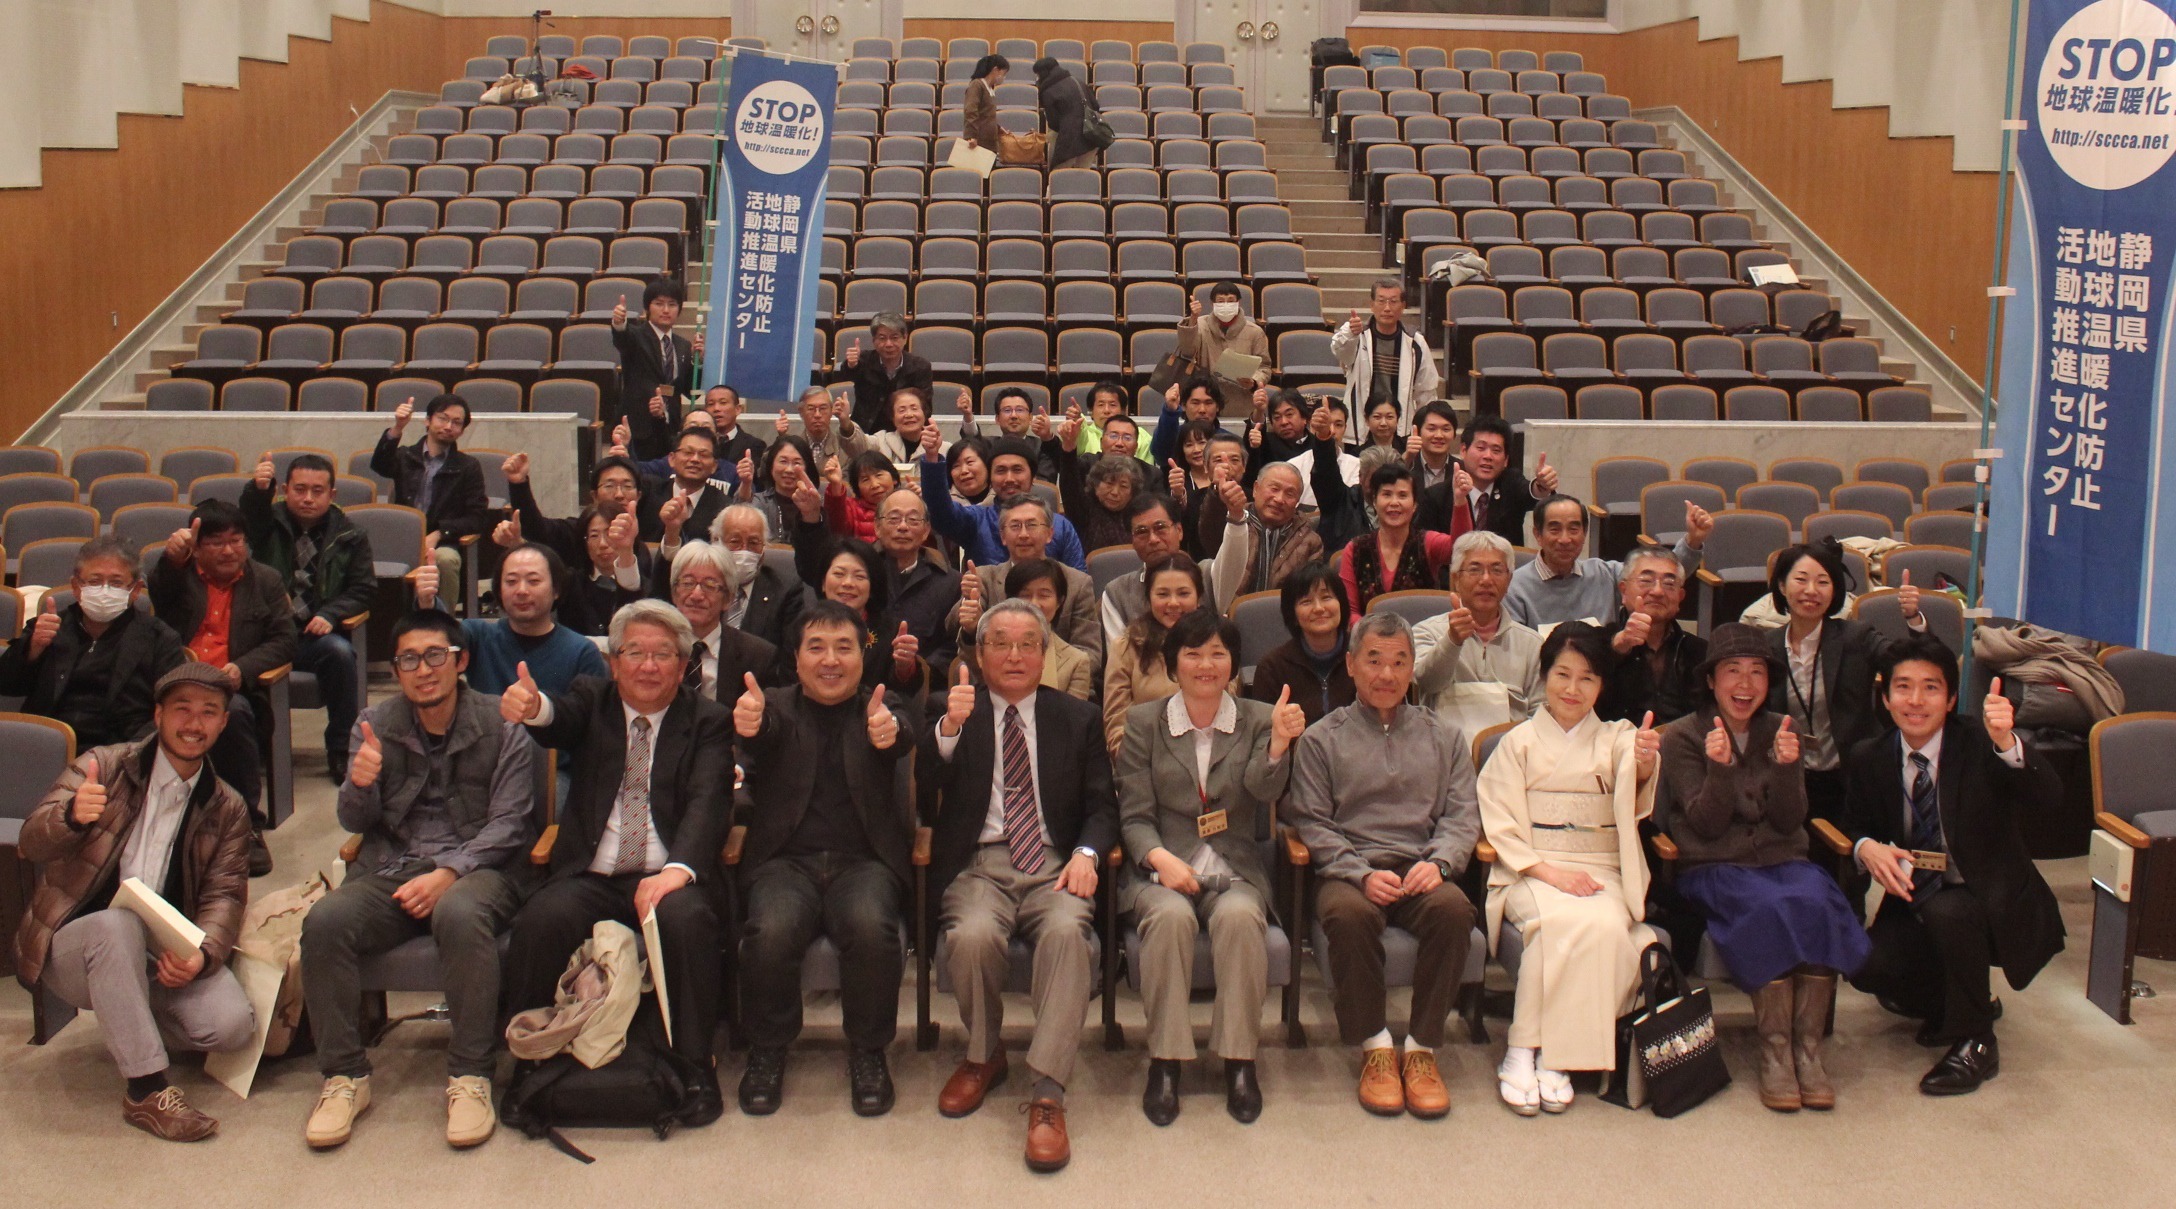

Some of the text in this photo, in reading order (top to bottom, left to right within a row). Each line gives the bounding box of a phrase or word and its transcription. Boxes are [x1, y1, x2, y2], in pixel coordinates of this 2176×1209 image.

[2058, 38, 2176, 81] STOP
[748, 97, 816, 124] STOP
[2044, 84, 2176, 116] 地球温暖化
[740, 119, 819, 141] 地球温暖化!
[744, 141, 810, 156] http://sccca.net
[2051, 128, 2169, 150] http://sccca.net
[779, 194, 801, 254] 静岡県
[736, 190, 764, 349] 活動推進センター
[753, 192, 782, 334] 地球温暖化防止
[2114, 232, 2153, 354] 静岡県
[2042, 226, 2085, 537] 活動推進センター
[2070, 229, 2117, 511] 地球温暖化防止
